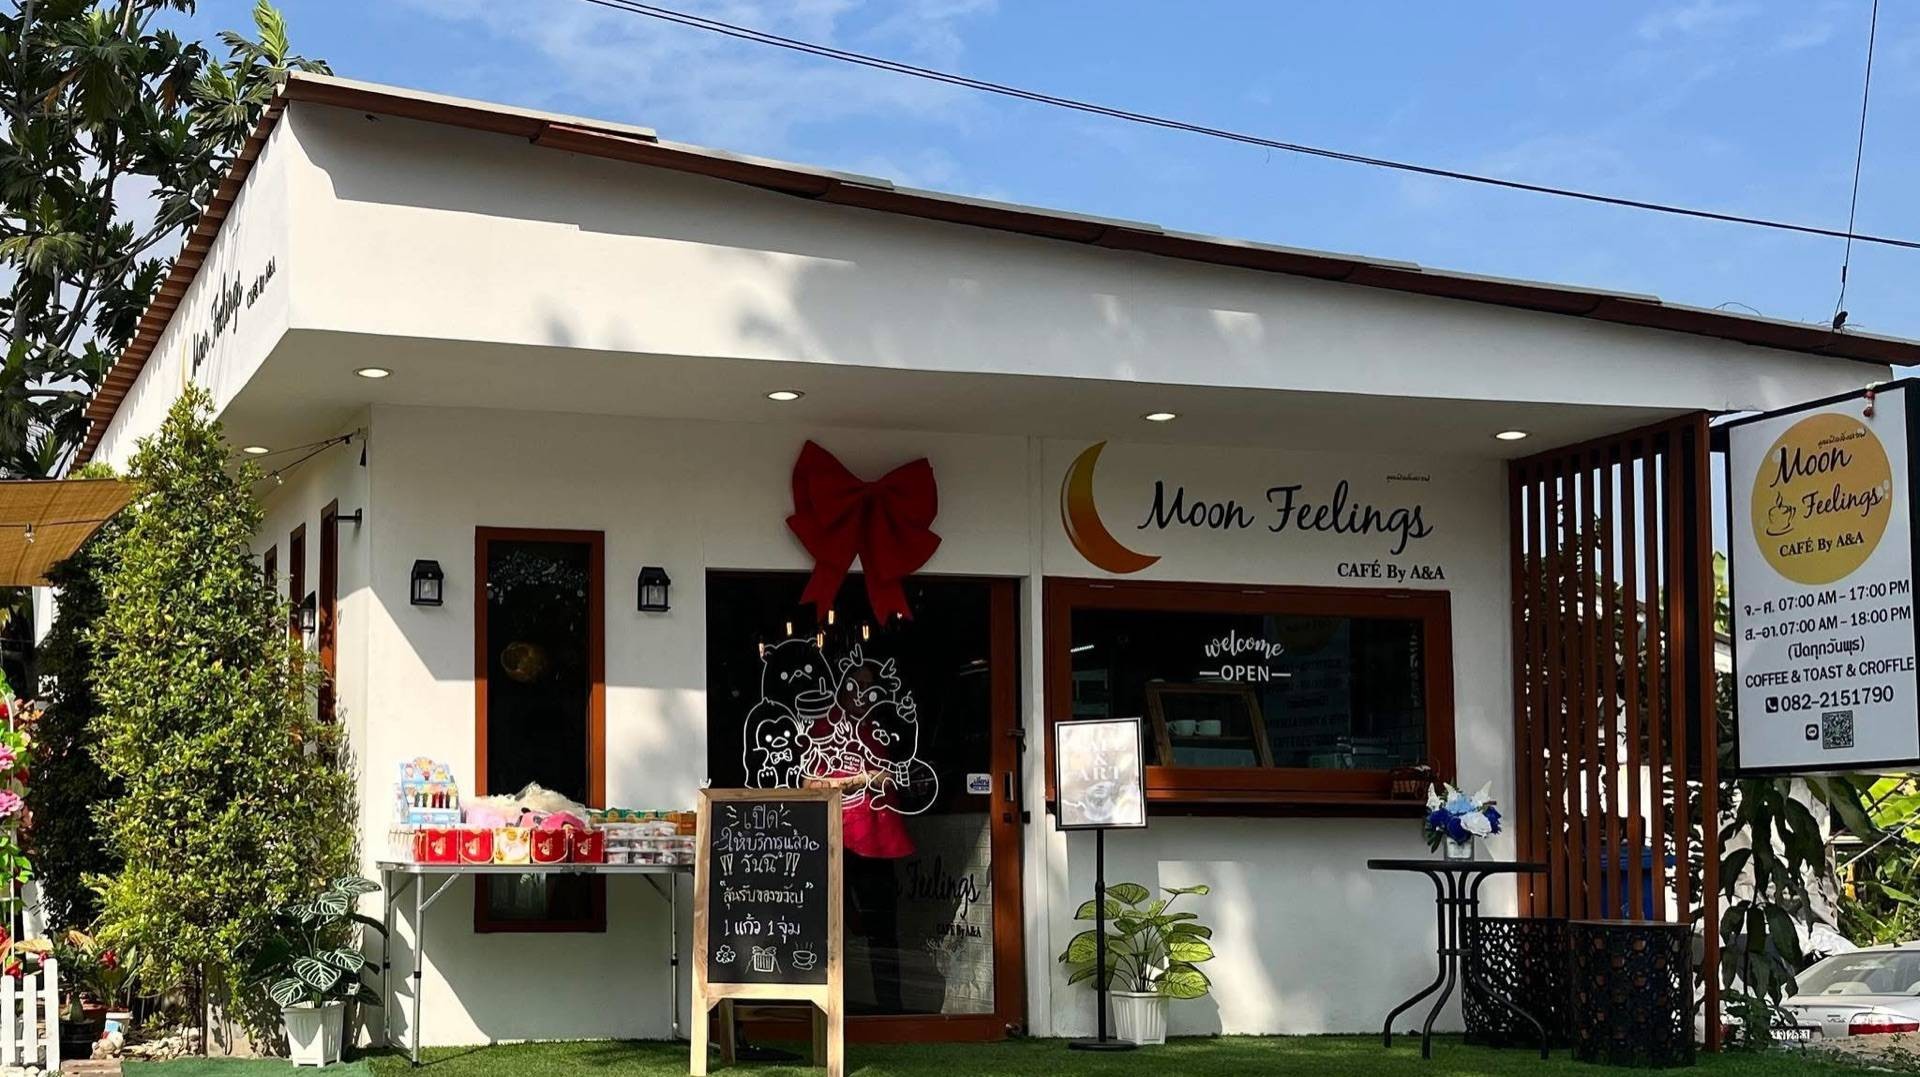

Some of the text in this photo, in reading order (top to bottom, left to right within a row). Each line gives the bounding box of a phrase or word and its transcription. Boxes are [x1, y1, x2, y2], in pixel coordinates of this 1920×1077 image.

[1770, 447, 1852, 488] Moon
[1802, 483, 1882, 518] Feelings
[1137, 480, 1433, 555] Moon Feelings
[1780, 531, 1864, 557] CAFÉ By A&A
[1337, 560, 1445, 582] CAFÉ By A&A
[1779, 594, 1814, 611] 07:00
[1817, 590, 1836, 606] AM
[1850, 583, 1886, 600] 17:00
[1889, 580, 1909, 595] PM
[1818, 616, 1838, 631] AM
[1851, 609, 1887, 626] 18:00
[1890, 605, 1911, 621] PM
[1205, 629, 1284, 659] welcome
[1221, 664, 1269, 682] OPEN
[1745, 657, 1914, 688] COFFEE & TOAST & CROFFLE
[1781, 685, 1894, 712] 082-2151790
[744, 804, 778, 829] เปิด
[718, 827, 809, 851] ให้บริการแล้ว
[735, 913, 760, 935] แก้ว
[767, 919, 774, 936] 1
